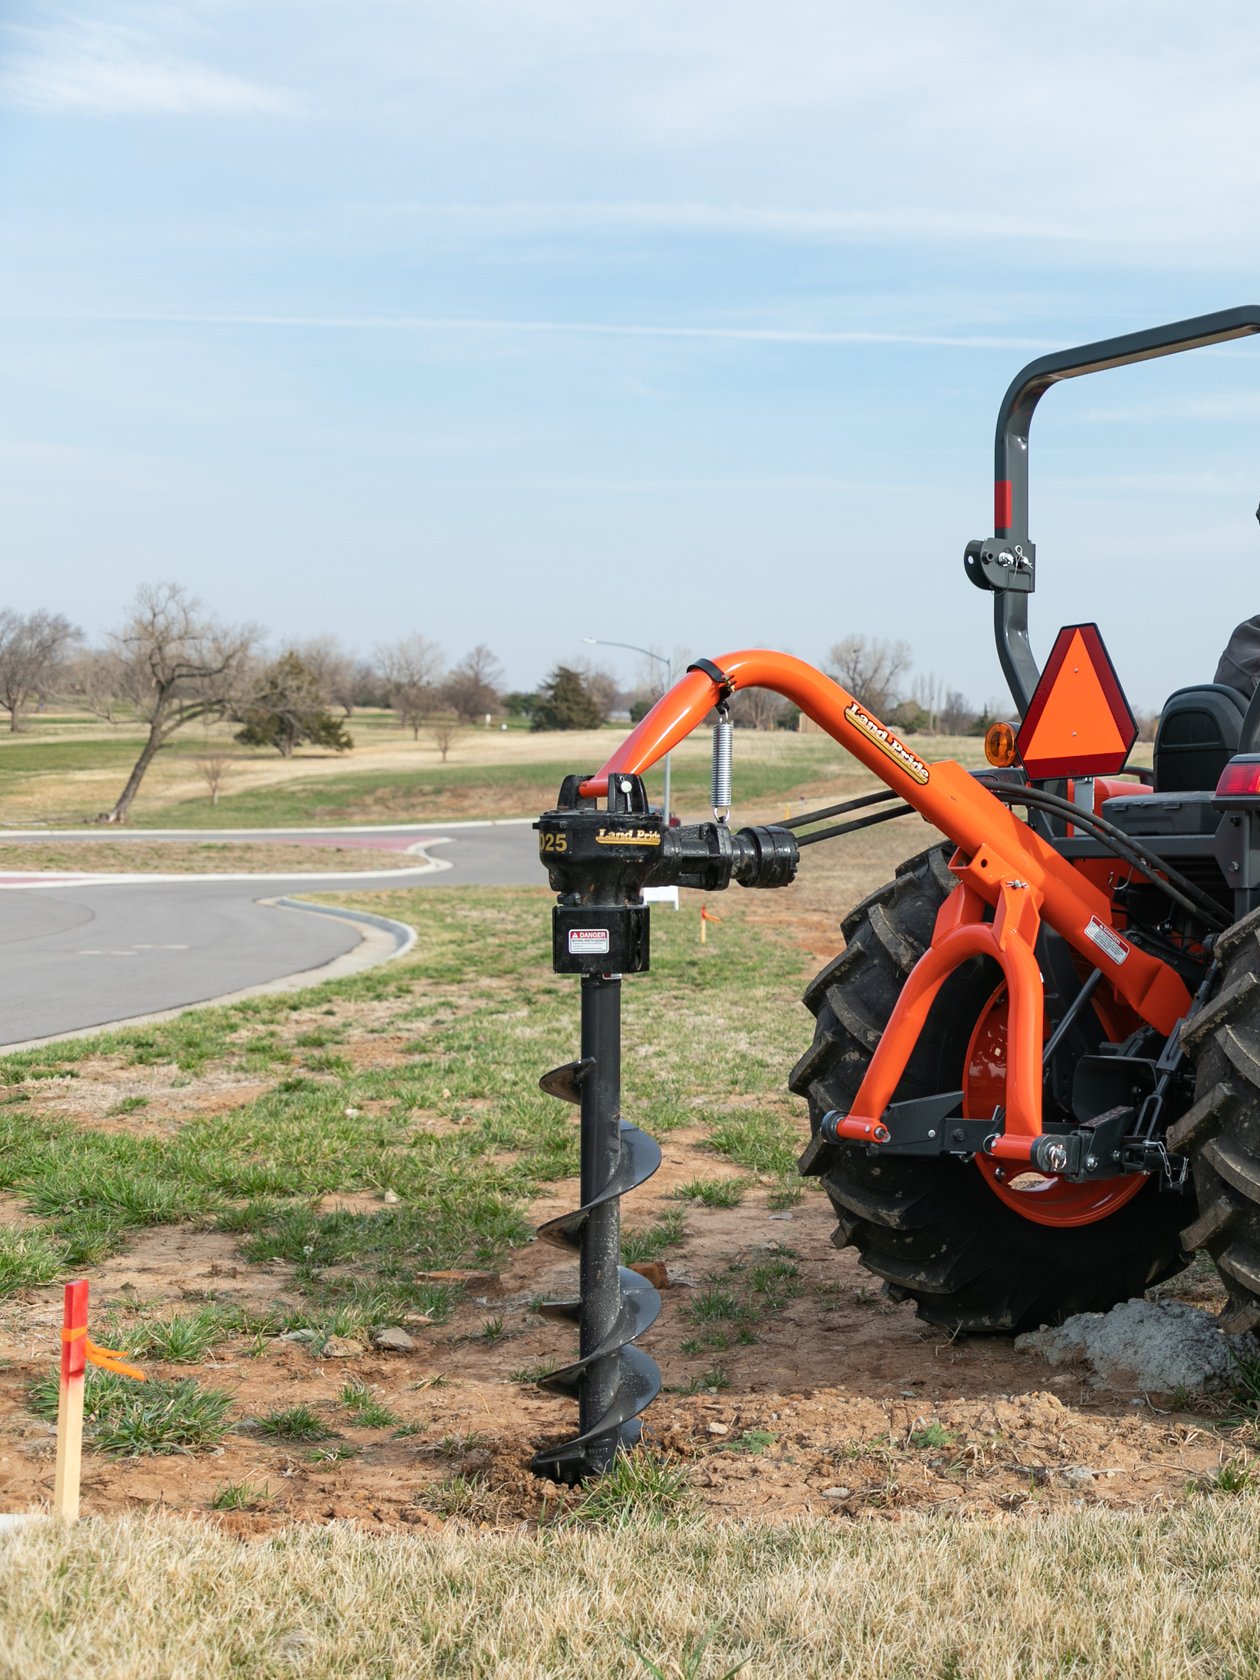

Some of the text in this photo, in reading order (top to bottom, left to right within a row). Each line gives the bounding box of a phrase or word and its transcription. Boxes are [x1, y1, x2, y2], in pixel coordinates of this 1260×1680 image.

[850, 703, 929, 778] Land Pride
[598, 829, 633, 839] Land
